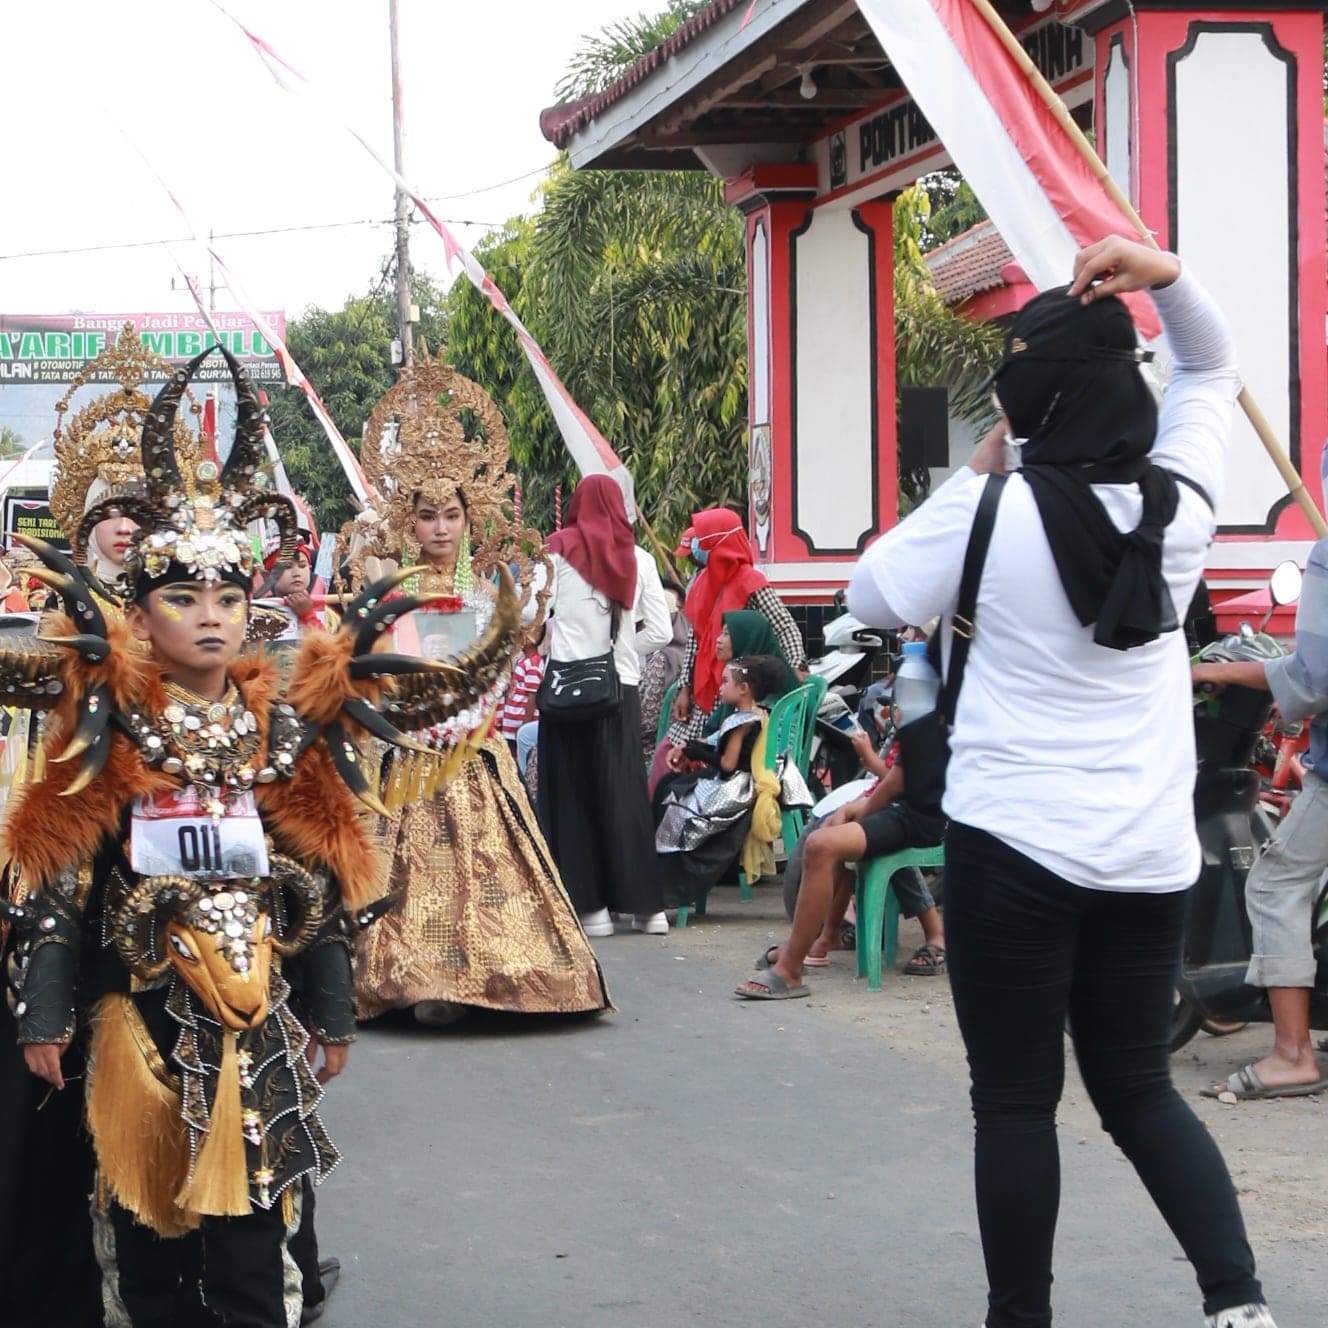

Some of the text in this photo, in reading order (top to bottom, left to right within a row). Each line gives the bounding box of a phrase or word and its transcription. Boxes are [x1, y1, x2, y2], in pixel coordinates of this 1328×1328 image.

[72, 315, 135, 331] Bangg
[140, 314, 180, 329] Jadi
[116, 330, 277, 359] MBULU
[40, 360, 84, 370] OTOMOTIF
[40, 371, 62, 381] TATA
[17, 517, 57, 528] SENI TARI
[17, 527, 65, 539] TRADISIONA
[177, 824, 223, 872] 011
